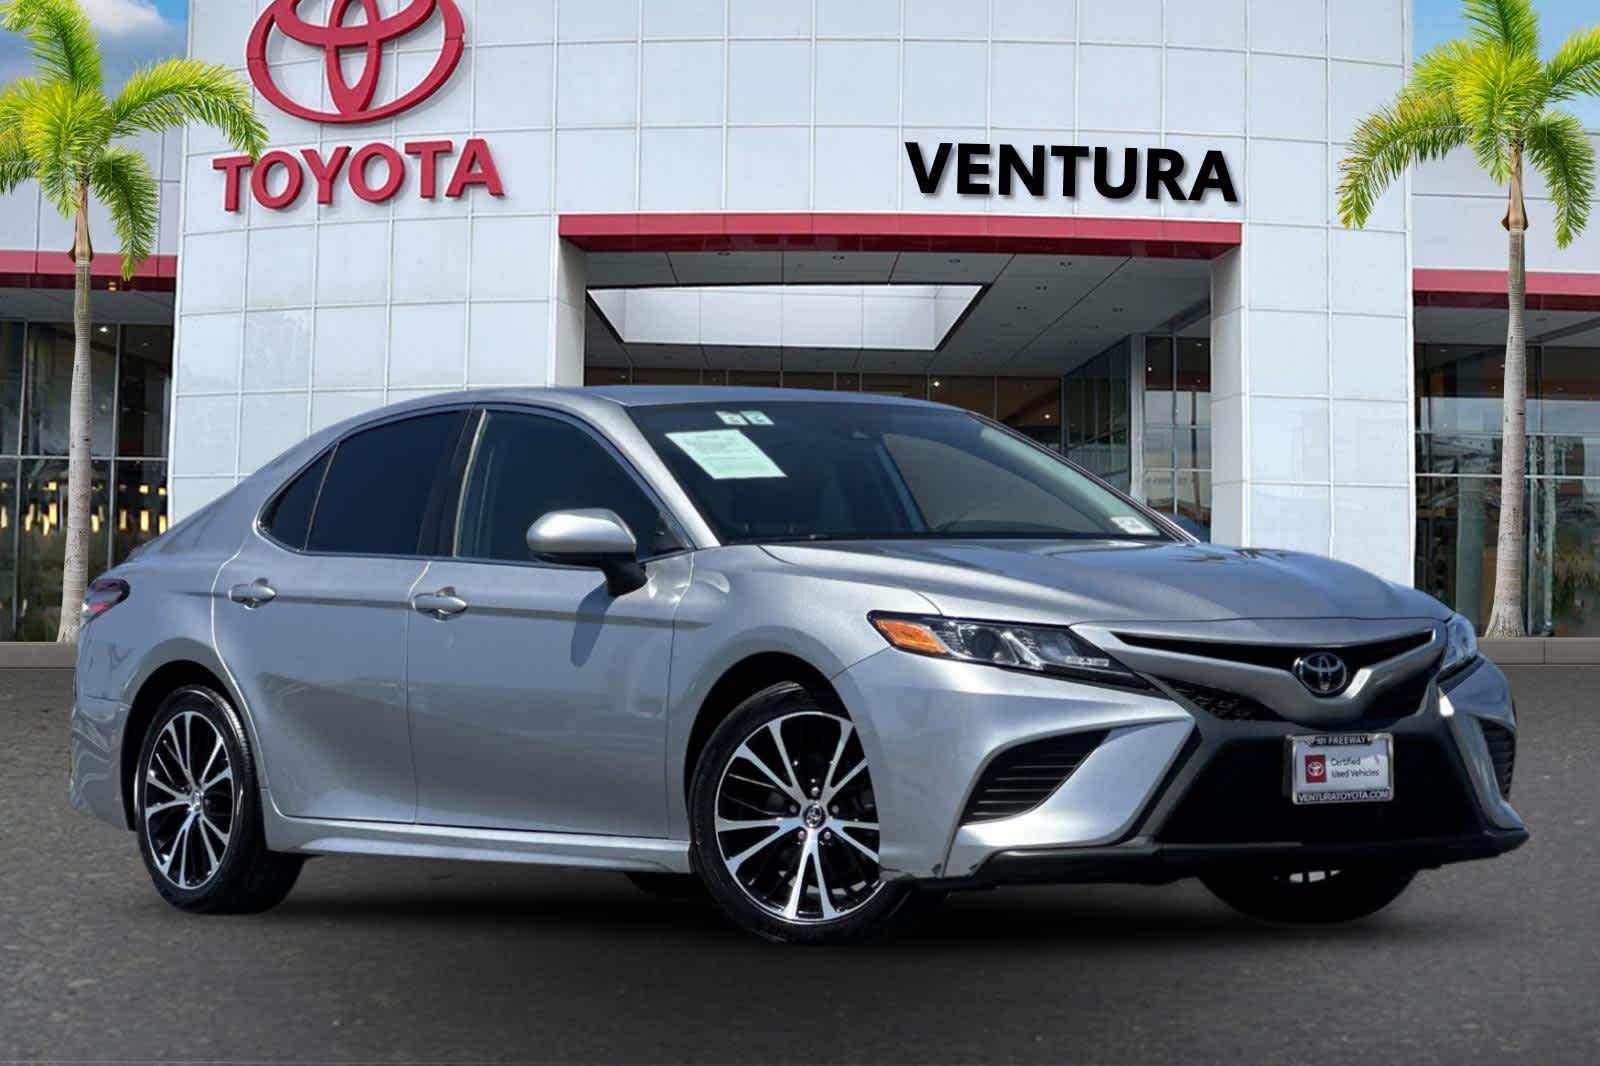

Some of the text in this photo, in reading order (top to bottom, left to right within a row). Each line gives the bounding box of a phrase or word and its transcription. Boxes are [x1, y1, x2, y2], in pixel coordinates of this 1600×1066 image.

[212, 138, 504, 212] TOYOTA
[905, 142, 1238, 203] VENTURA
[1328, 735, 1367, 745] FREEWAY
[1330, 758, 1361, 767] Certified
[1331, 769, 1379, 779] Used Vehicles
[1298, 791, 1389, 802] VENTURATOYOTA.COM
